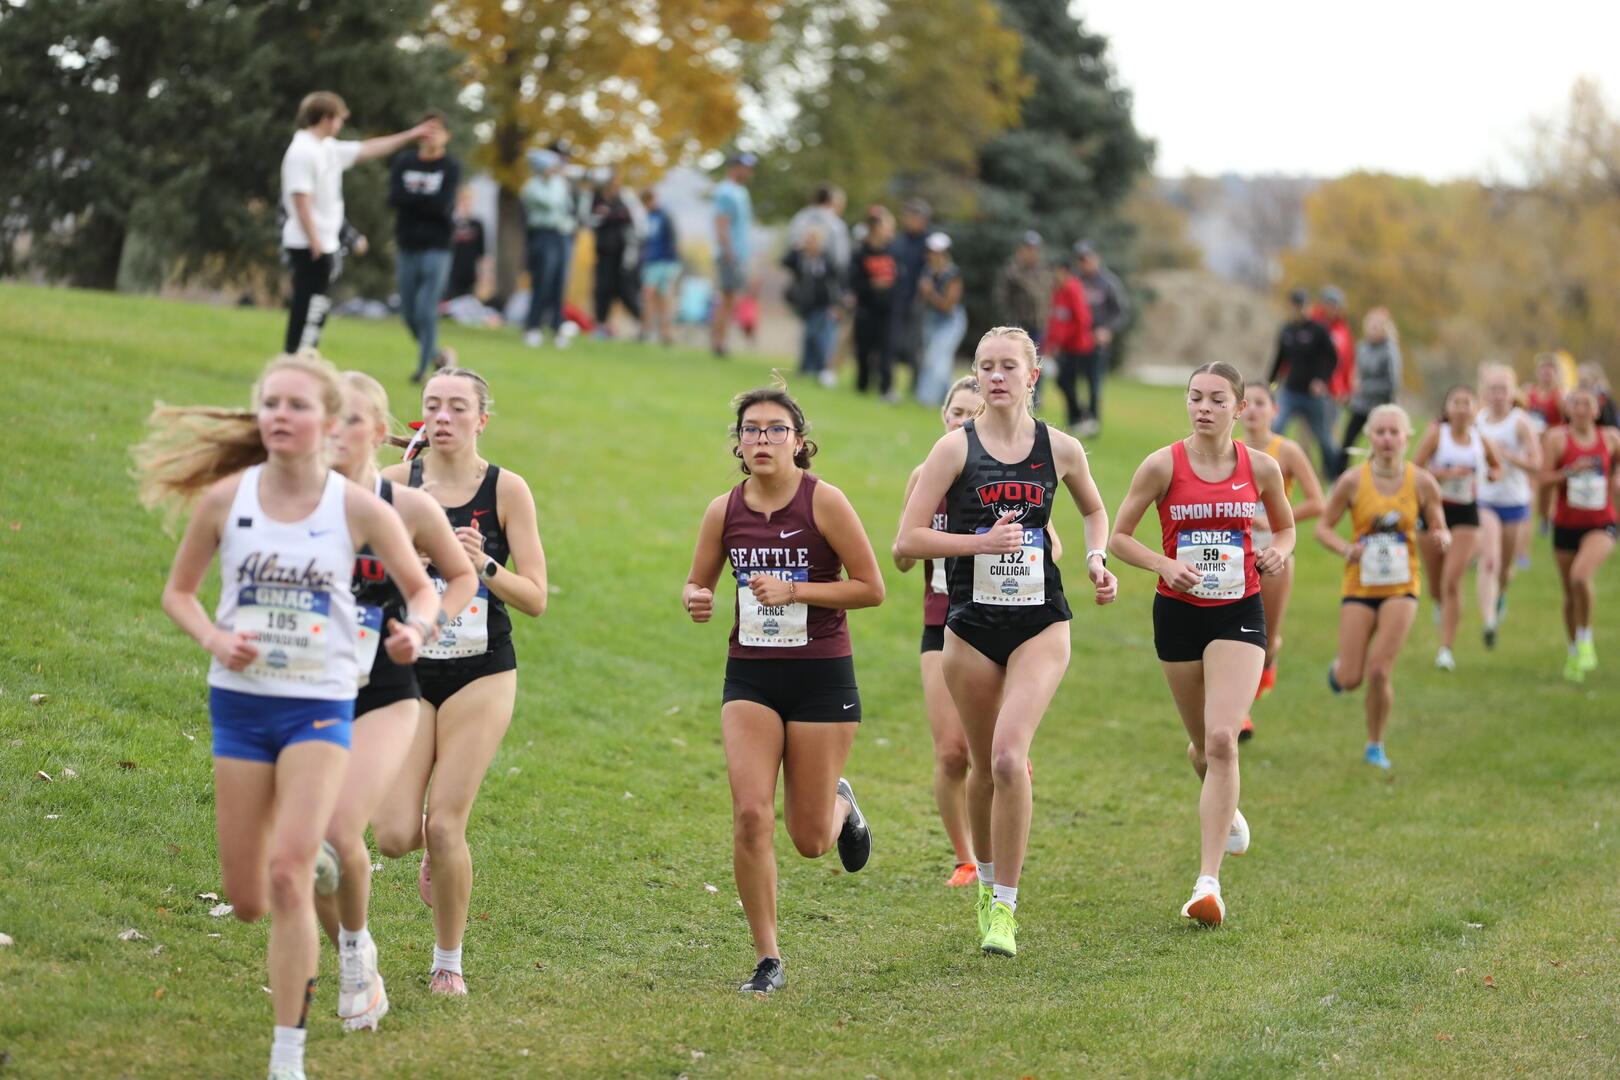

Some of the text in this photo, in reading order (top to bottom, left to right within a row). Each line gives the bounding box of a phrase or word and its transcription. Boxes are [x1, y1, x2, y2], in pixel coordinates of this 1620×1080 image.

[979, 482, 1043, 505] WOU
[1169, 503, 1212, 520] SIMON
[1191, 531, 1231, 545] GNAC
[730, 548, 808, 567] SEATTLE
[999, 549, 1024, 564] 132
[1203, 548, 1219, 561] 59
[236, 551, 334, 588] Alaska
[990, 565, 1031, 576] CULLIGAN
[1195, 562, 1226, 572] MATHIS
[255, 586, 315, 611] GNAC
[757, 605, 785, 616] PIERCE
[267, 611, 297, 631] 105
